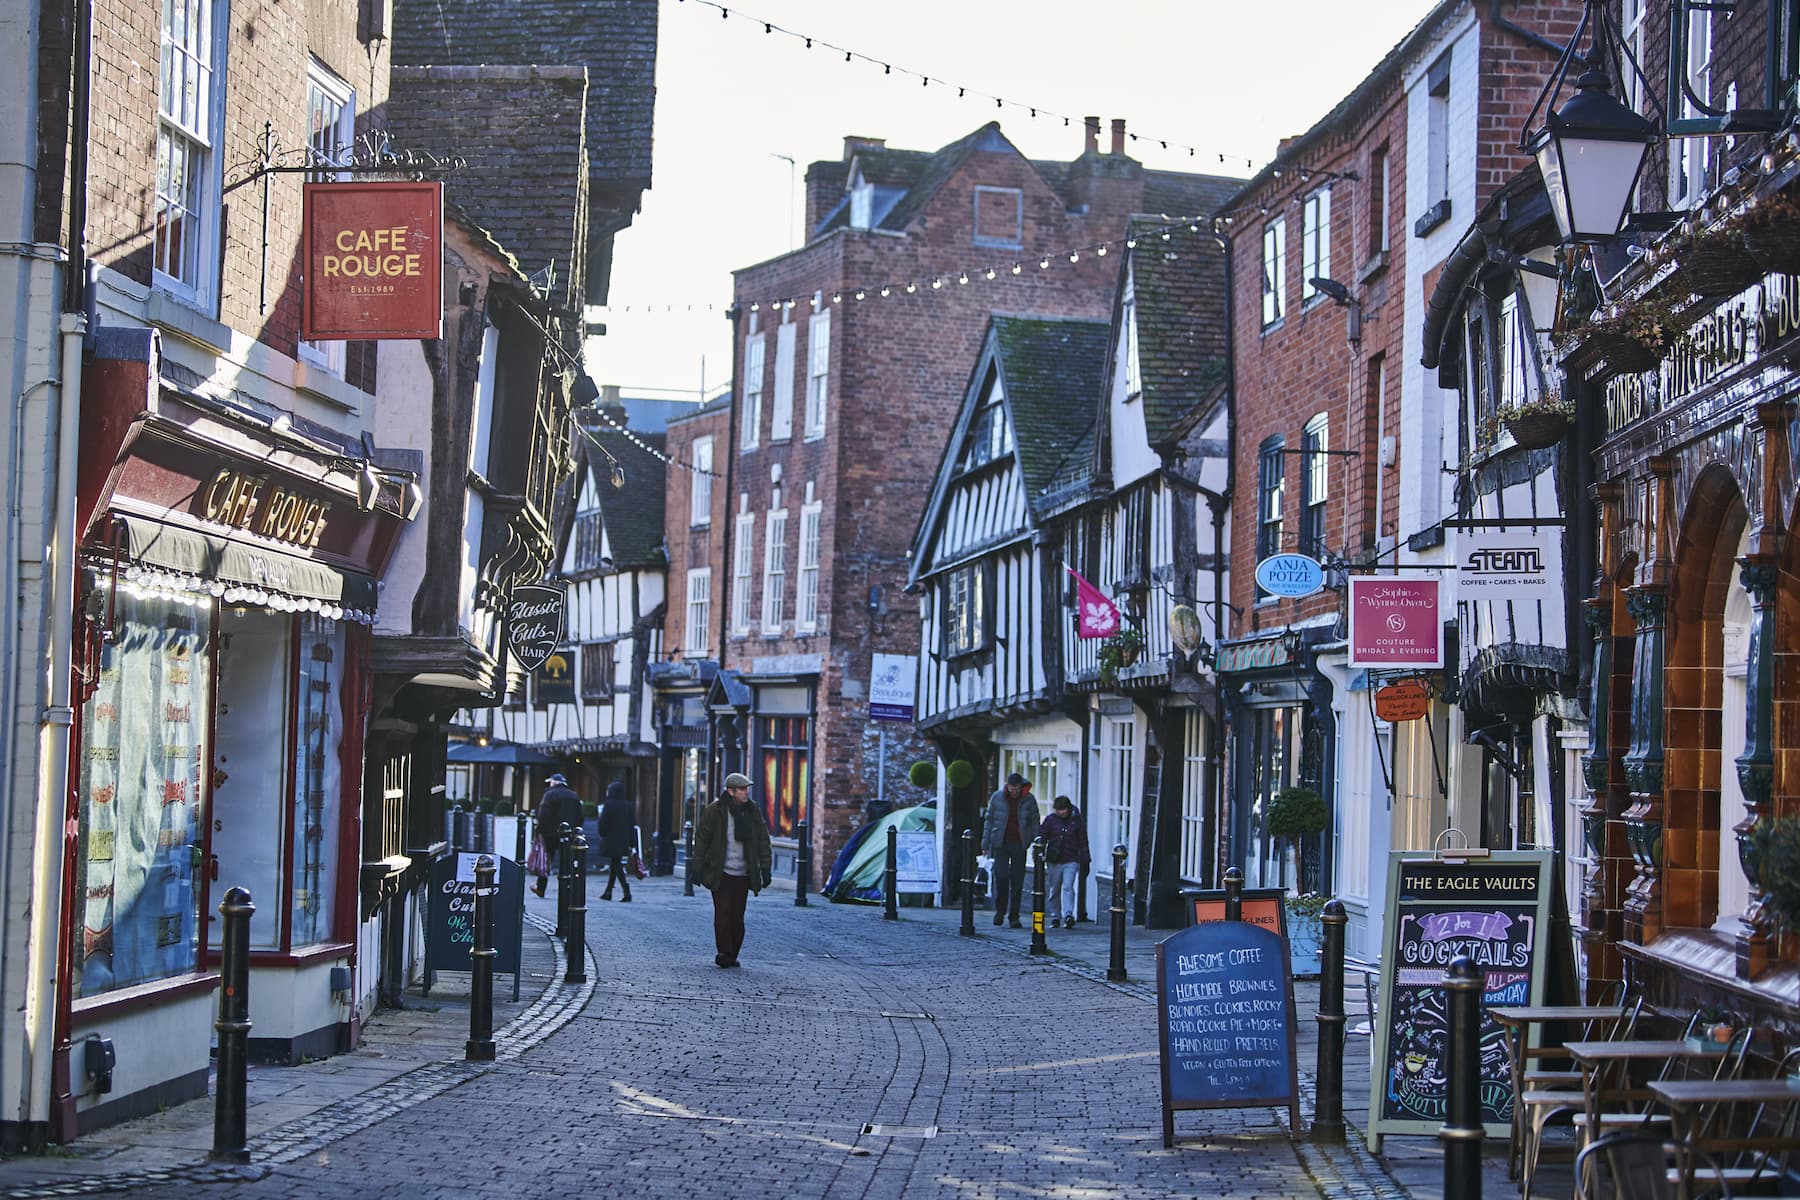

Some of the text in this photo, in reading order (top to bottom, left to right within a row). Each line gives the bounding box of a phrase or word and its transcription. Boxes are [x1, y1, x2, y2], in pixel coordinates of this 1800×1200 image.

[336, 226, 408, 251] CAFÉ
[324, 254, 421, 277] ROUGE
[1606, 373, 1642, 433] WINES
[263, 489, 329, 547] ROUGE
[1274, 559, 1308, 570] ANJA
[1461, 548, 1545, 574] STEAM
[1269, 571, 1312, 582] POTZE
[1375, 587, 1420, 598] Sophie
[510, 598, 560, 622] Classic
[509, 622, 555, 643] Cuts
[521, 646, 546, 659] HAIR
[1405, 877, 1536, 890] THE EAGLE VAULTS
[1438, 916, 1450, 935] 2
[1476, 916, 1488, 935] 1
[1178, 948, 1261, 971] AWESOME COFFEE
[1403, 940, 1528, 967] COCKTAILS
[1486, 973, 1525, 990] ALL DAY
[1176, 983, 1223, 1000] HOMEMADE
[1485, 984, 1527, 1003] EVERY DAY
[1253, 999, 1282, 1012] ROCKY
[1197, 1020, 1227, 1033] COOKIE
[1230, 1018, 1243, 1031] PIE
[1251, 1018, 1278, 1031] MORE
[1174, 1036, 1280, 1052] HAND ROLLED PRETZELS
